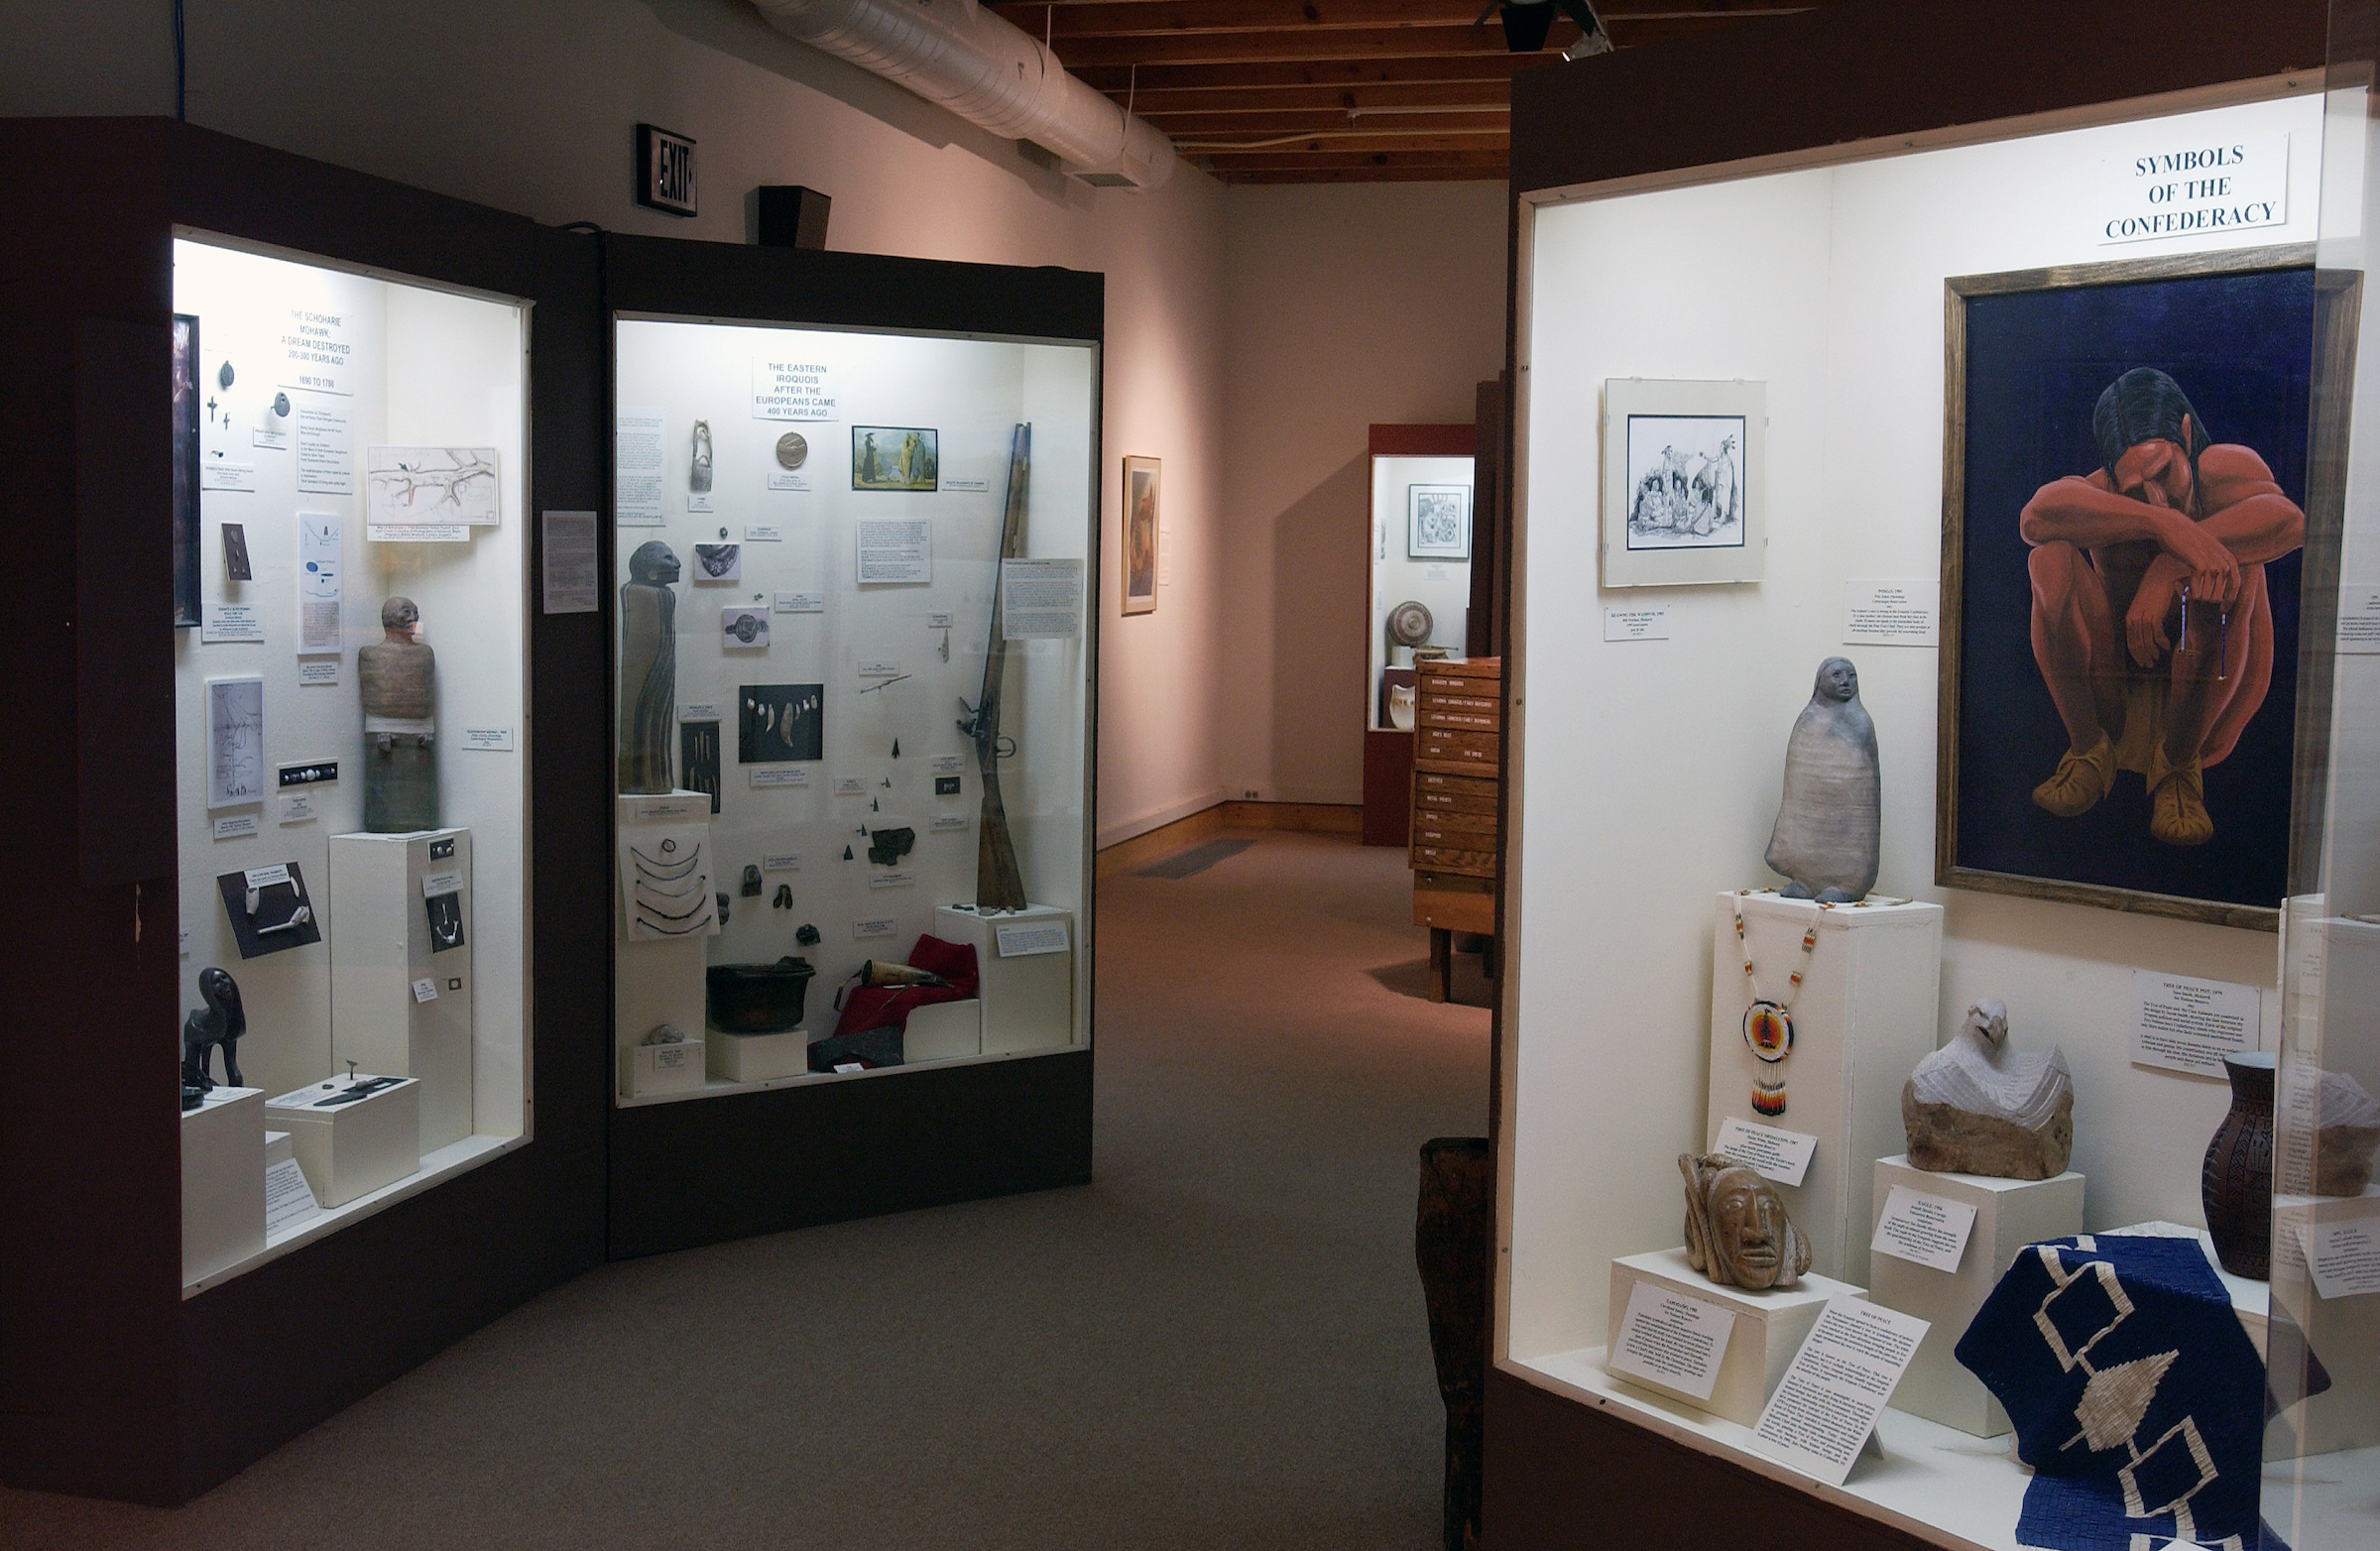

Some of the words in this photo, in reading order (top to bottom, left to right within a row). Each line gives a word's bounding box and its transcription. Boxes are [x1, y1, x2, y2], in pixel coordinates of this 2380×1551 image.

[2135, 145, 2244, 178] SYMBOLS
[660, 139, 689, 203] EXIT
[2149, 183, 2179, 204] OF
[2184, 177, 2231, 199] THE
[2105, 200, 2278, 239] CONFEDERACY
[291, 309, 302, 320] THE
[305, 312, 341, 327] SCHOHARIE
[288, 336, 310, 348] DREAM
[312, 340, 350, 355] DESTROYED
[311, 353, 329, 364] YEARS
[331, 357, 343, 366] AGO
[768, 362, 784, 372] THE
[787, 363, 827, 373] EASTERN
[312, 377, 321, 387] TO
[776, 375, 819, 384] IROQUOIS
[774, 386, 802, 395] AFTER
[756, 396, 809, 406] EUROPEANS
[812, 398, 836, 407] CAME
[768, 407, 780, 416] 400
[782, 408, 809, 417] YEARS
